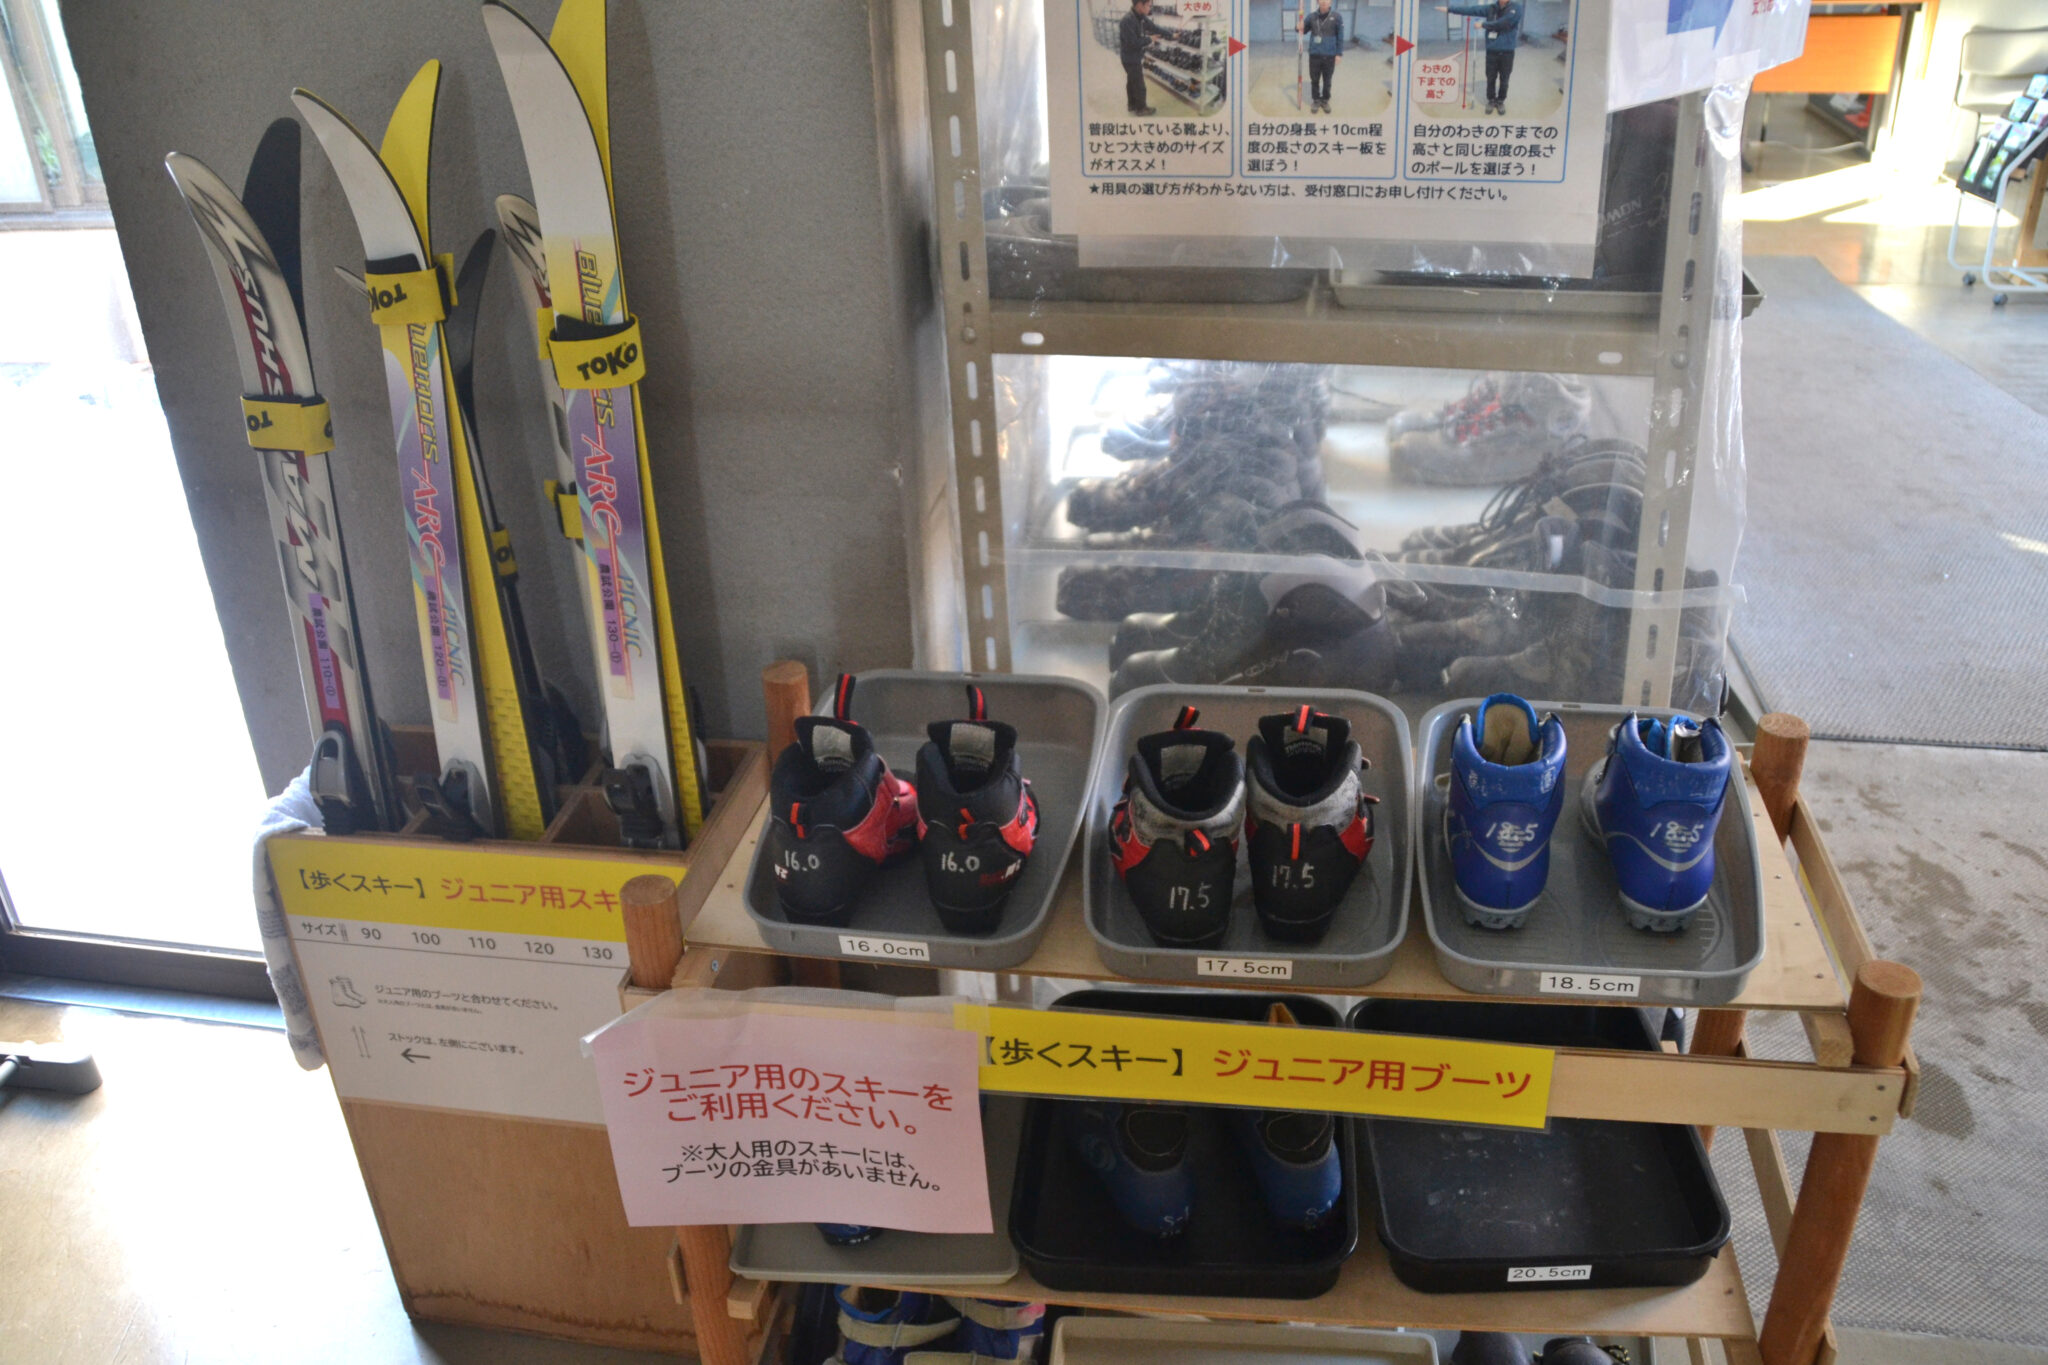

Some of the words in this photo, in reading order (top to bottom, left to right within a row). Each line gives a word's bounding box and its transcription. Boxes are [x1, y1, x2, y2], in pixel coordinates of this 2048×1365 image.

[1184, 2, 1212, 11] 大きめ
[1422, 64, 1452, 74] わきの
[1417, 76, 1456, 87] 下までの
[1426, 89, 1445, 99] 高さ
[1089, 123, 1231, 137] 普段はいている靴より、
[1413, 124, 1558, 140] 自分のわきの下までの
[1089, 140, 1224, 155] ひとつ大きめのサイズ
[1247, 141, 1387, 156] 度の長さのスキー板を
[1412, 142, 1556, 158] 高さと同じ程度の長さ
[368, 283, 407, 313] TOK
[577, 342, 639, 381] TOKO
[246, 411, 273, 432] TO
[581, 433, 621, 536] ARC
[411, 467, 446, 567] ARC
[617, 575, 643, 658] PICNIC
[785, 850, 820, 872] 16.0
[941, 852, 980, 873] 16.0
[1272, 862, 1315, 889] 17.5
[299, 868, 426, 899] 【歩くスキー】
[441, 878, 618, 912] ジュニア用スキ
[1169, 882, 1212, 911] 17.5
[302, 922, 337, 936] サイズ
[361, 927, 381, 940] 90
[411, 932, 441, 945] 100
[468, 936, 496, 950] 110
[524, 941, 554, 955] 120
[582, 946, 613, 960] 130
[846, 939, 924, 957] 16.0cm
[1204, 960, 1287, 976] 17.5cm
[1549, 976, 1634, 992] 18.5cm
[985, 1036, 1182, 1076] 【歩くスキー】
[1214, 1050, 1531, 1098] ジュニア用ブーツ
[623, 1063, 953, 1112] ジュニア用のスキーを
[667, 1093, 917, 1135] ご利用ください。
[682, 1140, 917, 1172] ※大人用のスキーには、
[661, 1159, 941, 1192] ブーツの金具があいません。
[1513, 1268, 1587, 1278] 20.5cm
